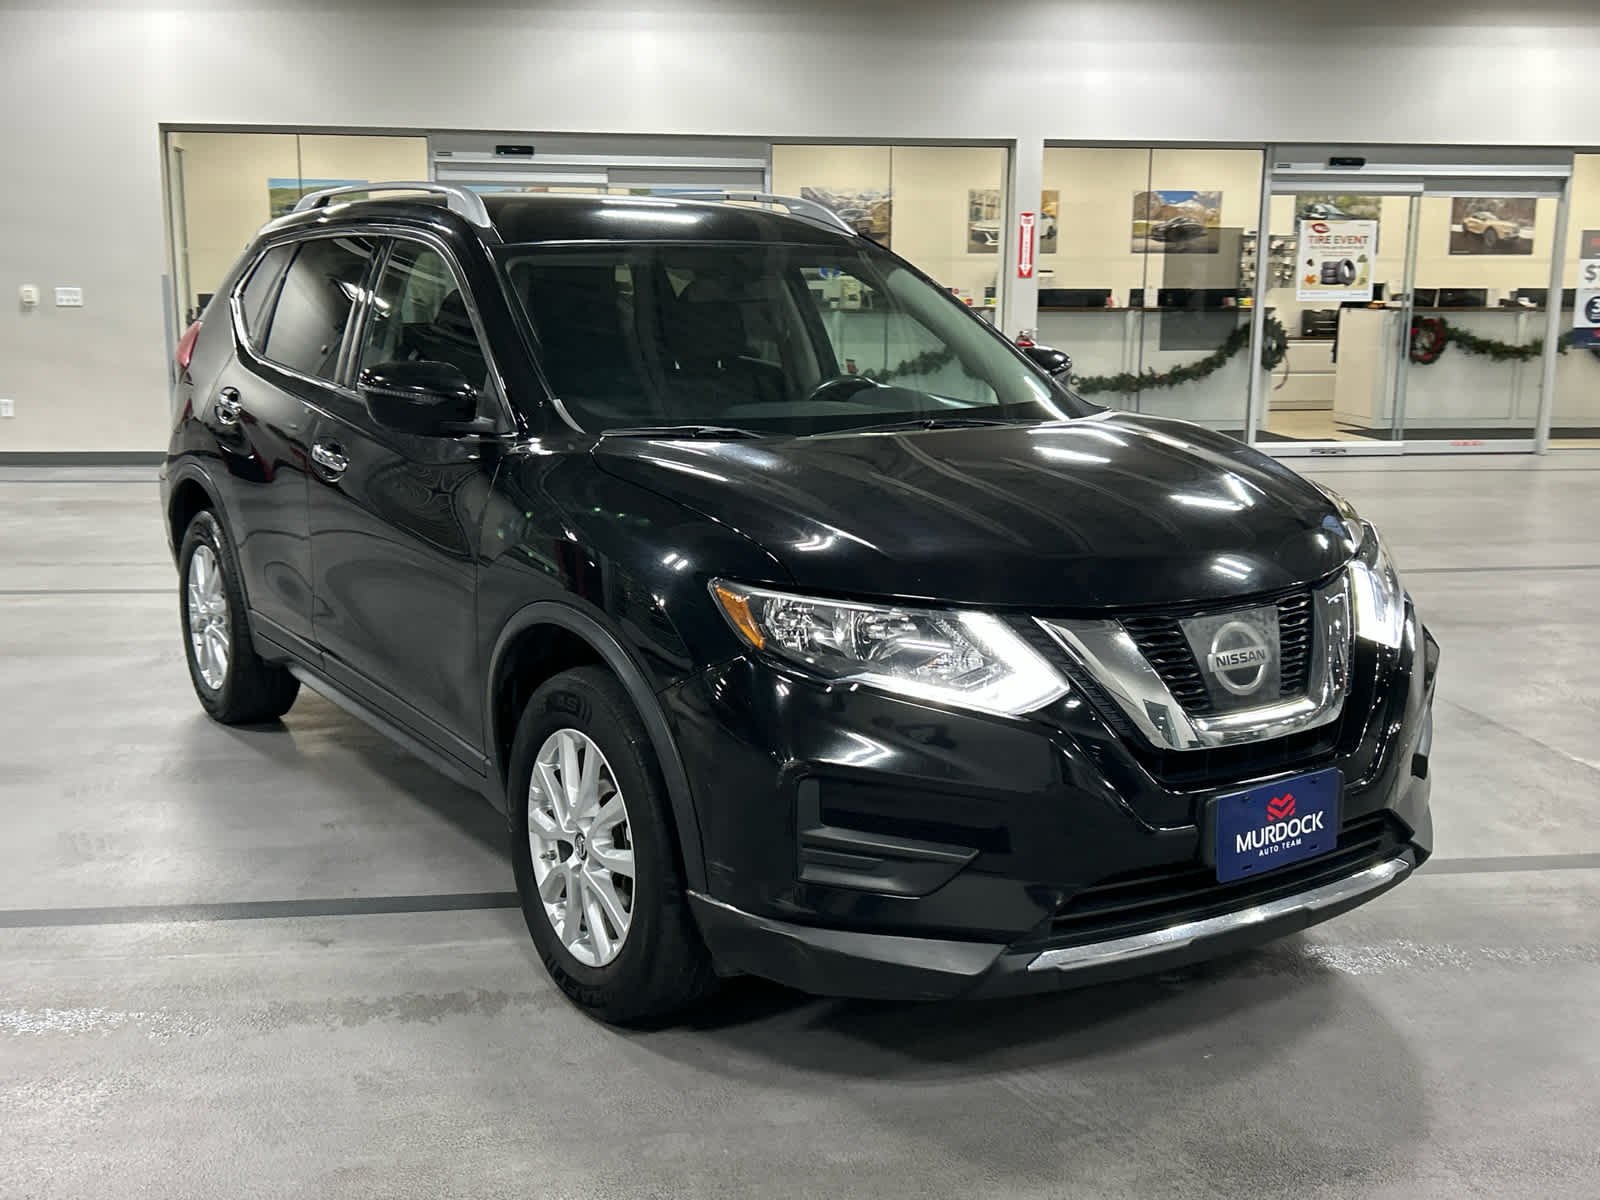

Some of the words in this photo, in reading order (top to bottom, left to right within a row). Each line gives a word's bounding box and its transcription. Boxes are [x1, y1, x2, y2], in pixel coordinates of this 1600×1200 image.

[1334, 235, 1368, 244] EVENT
[1215, 648, 1266, 668] NISSAN
[1236, 810, 1324, 853] MURDOCK
[1258, 844, 1279, 856] AUTO
[1281, 838, 1302, 850] TEAM
